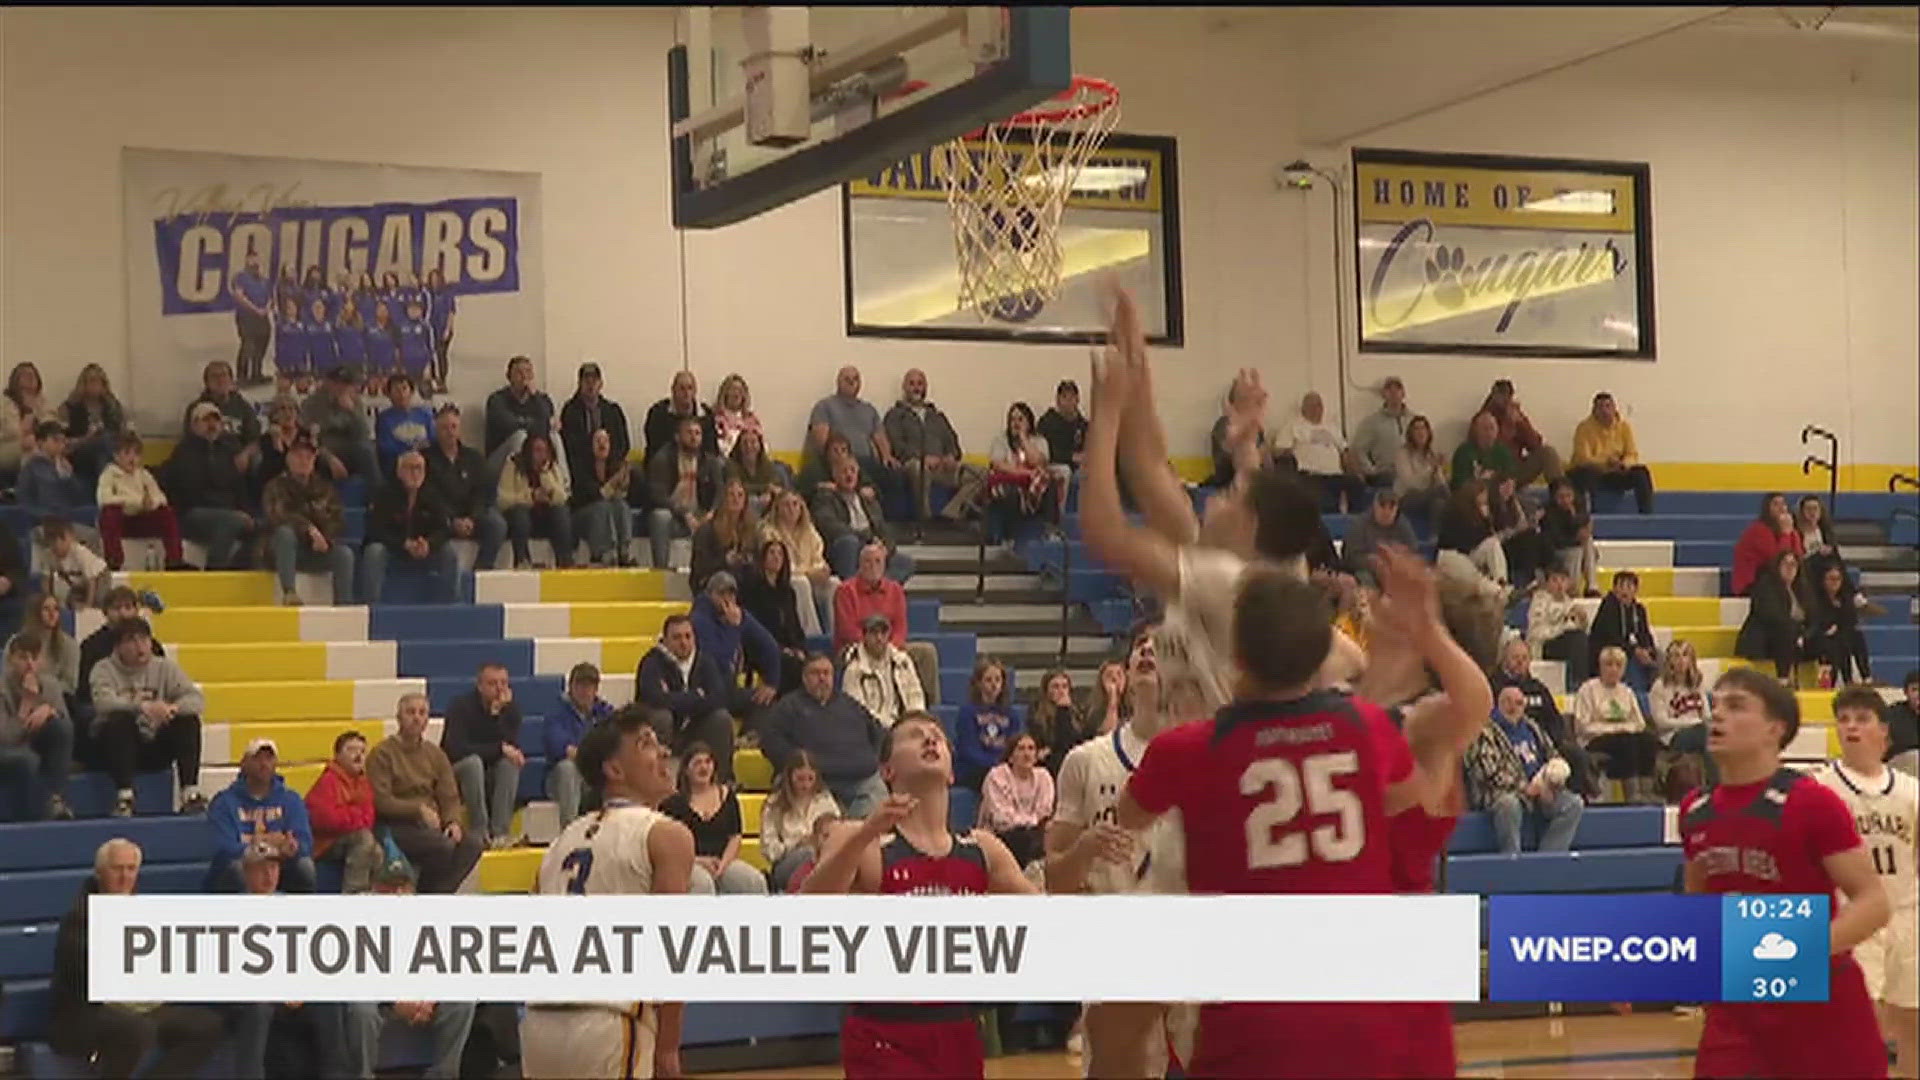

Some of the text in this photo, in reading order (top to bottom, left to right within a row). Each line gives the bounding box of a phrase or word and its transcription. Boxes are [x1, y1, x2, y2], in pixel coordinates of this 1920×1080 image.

[1373, 178, 1470, 208] HOME
[1493, 183, 1532, 209] OF
[176, 208, 508, 302] COUGARS
[1239, 750, 1366, 870] 25
[1872, 845, 1897, 875] 11
